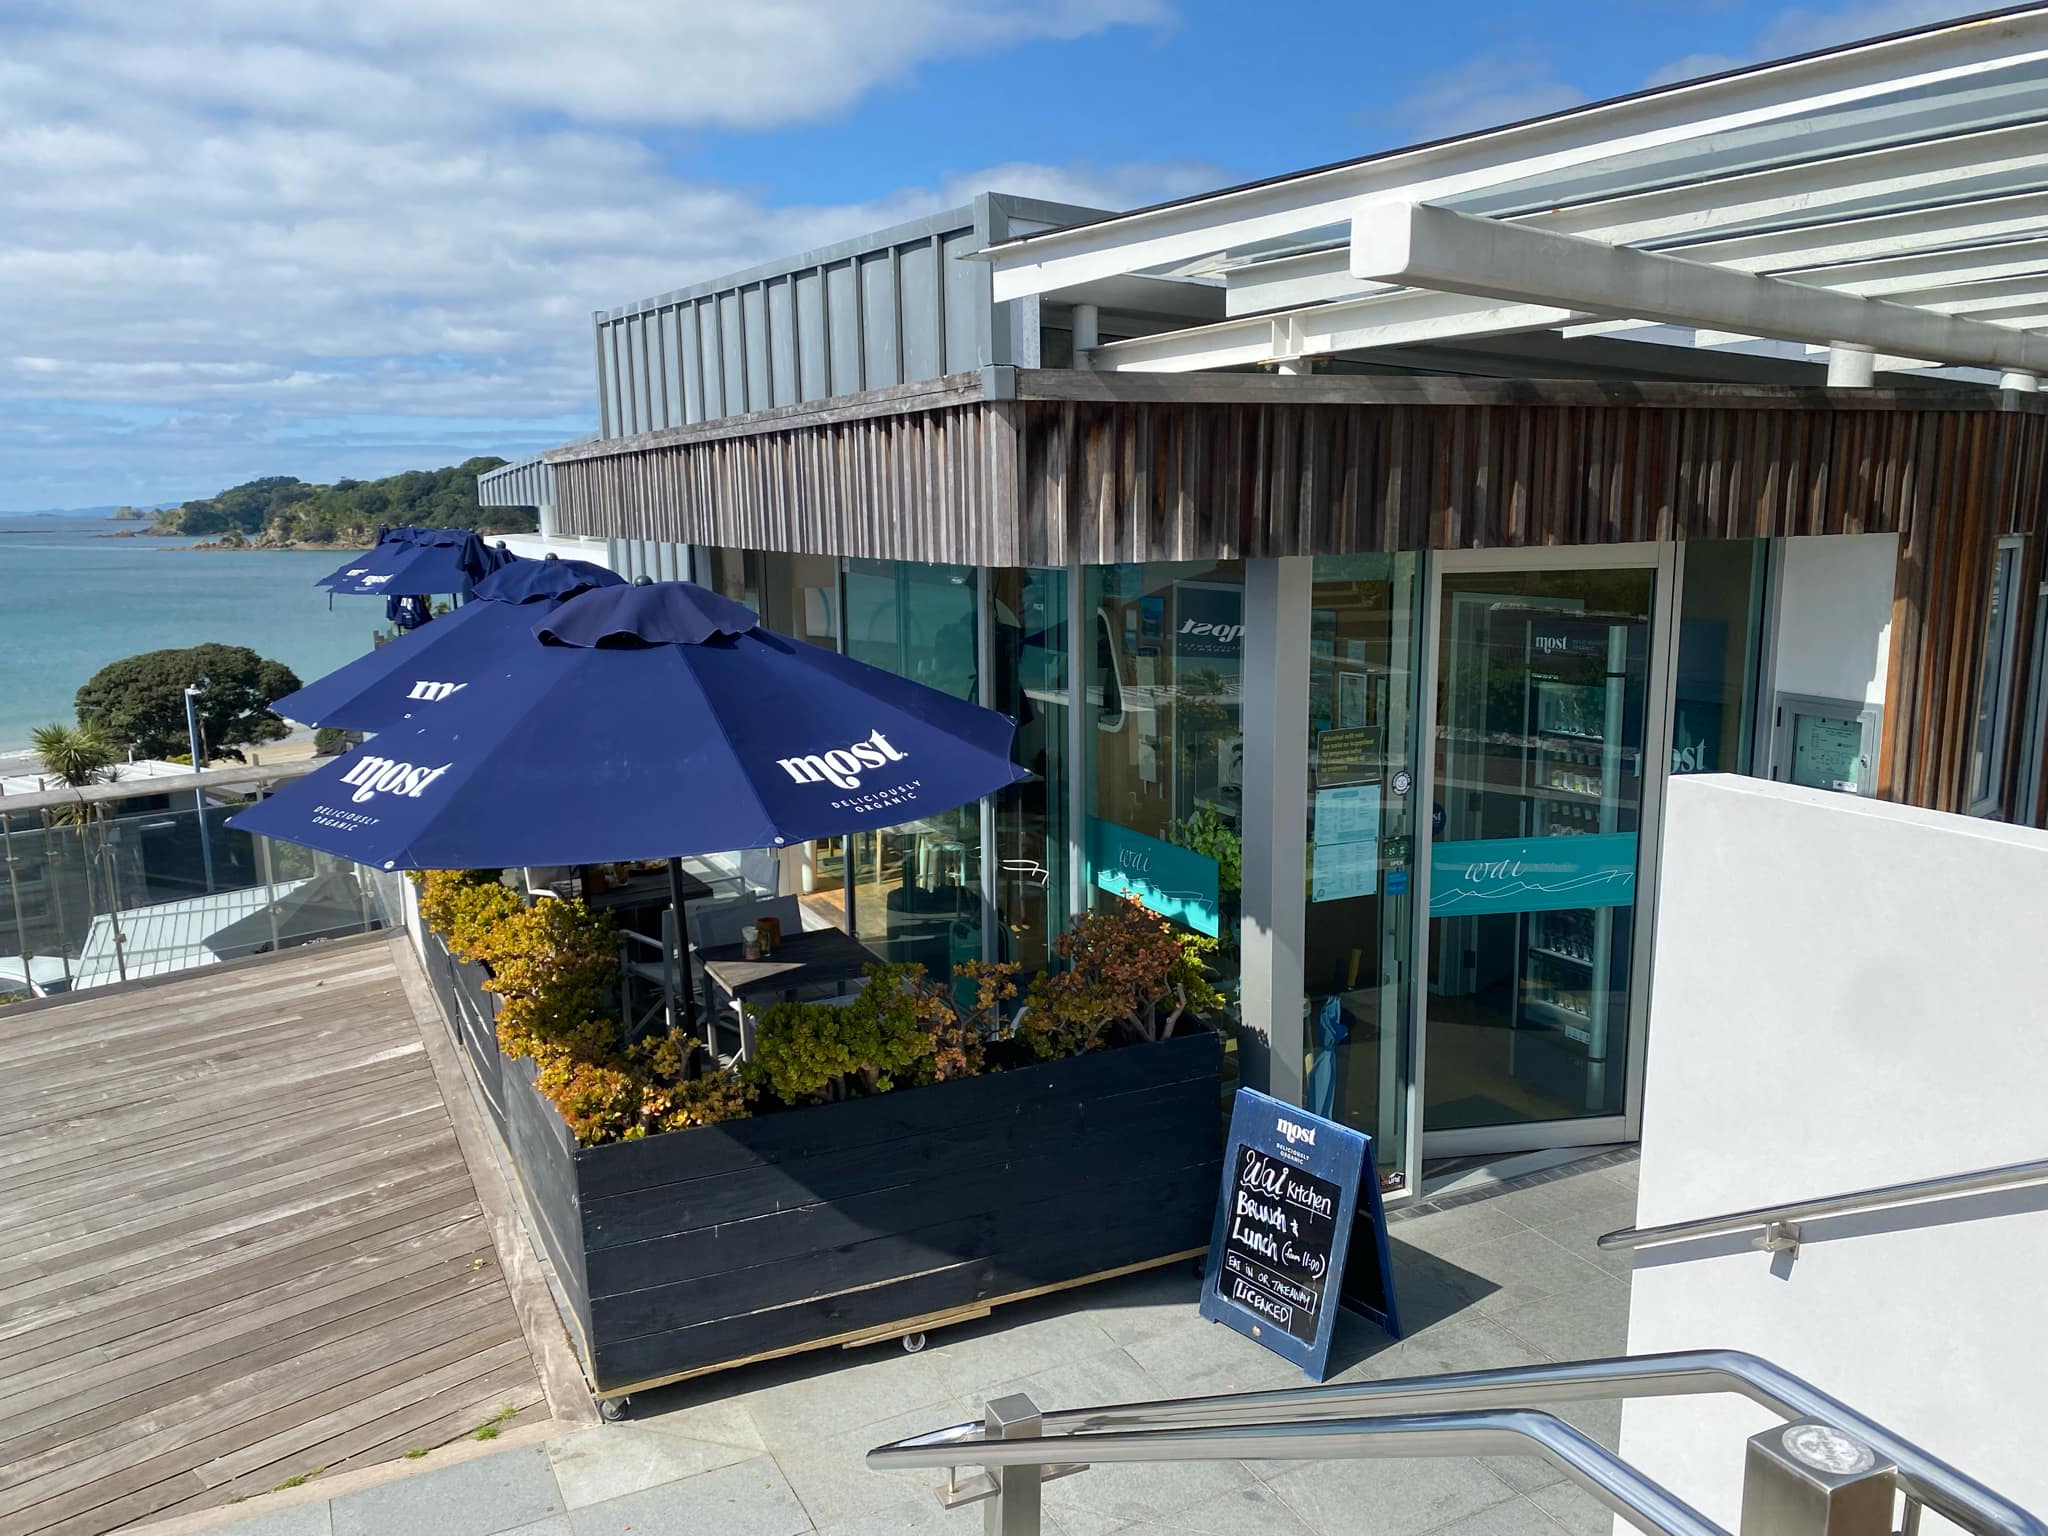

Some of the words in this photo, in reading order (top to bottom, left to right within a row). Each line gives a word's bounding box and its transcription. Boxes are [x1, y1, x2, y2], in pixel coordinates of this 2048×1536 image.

[1535, 635, 1567, 654] most
[775, 728, 905, 789] most
[340, 755, 453, 803] most
[831, 779, 921, 809] DELICIOUSLY
[855, 792, 917, 813] ORGANIC
[312, 816, 358, 831] ORGANIC
[313, 805, 381, 825] DELICIOUSLY
[1276, 1118, 1316, 1146] most
[1242, 1150, 1289, 1194] Wai
[1257, 1273, 1271, 1288] OR
